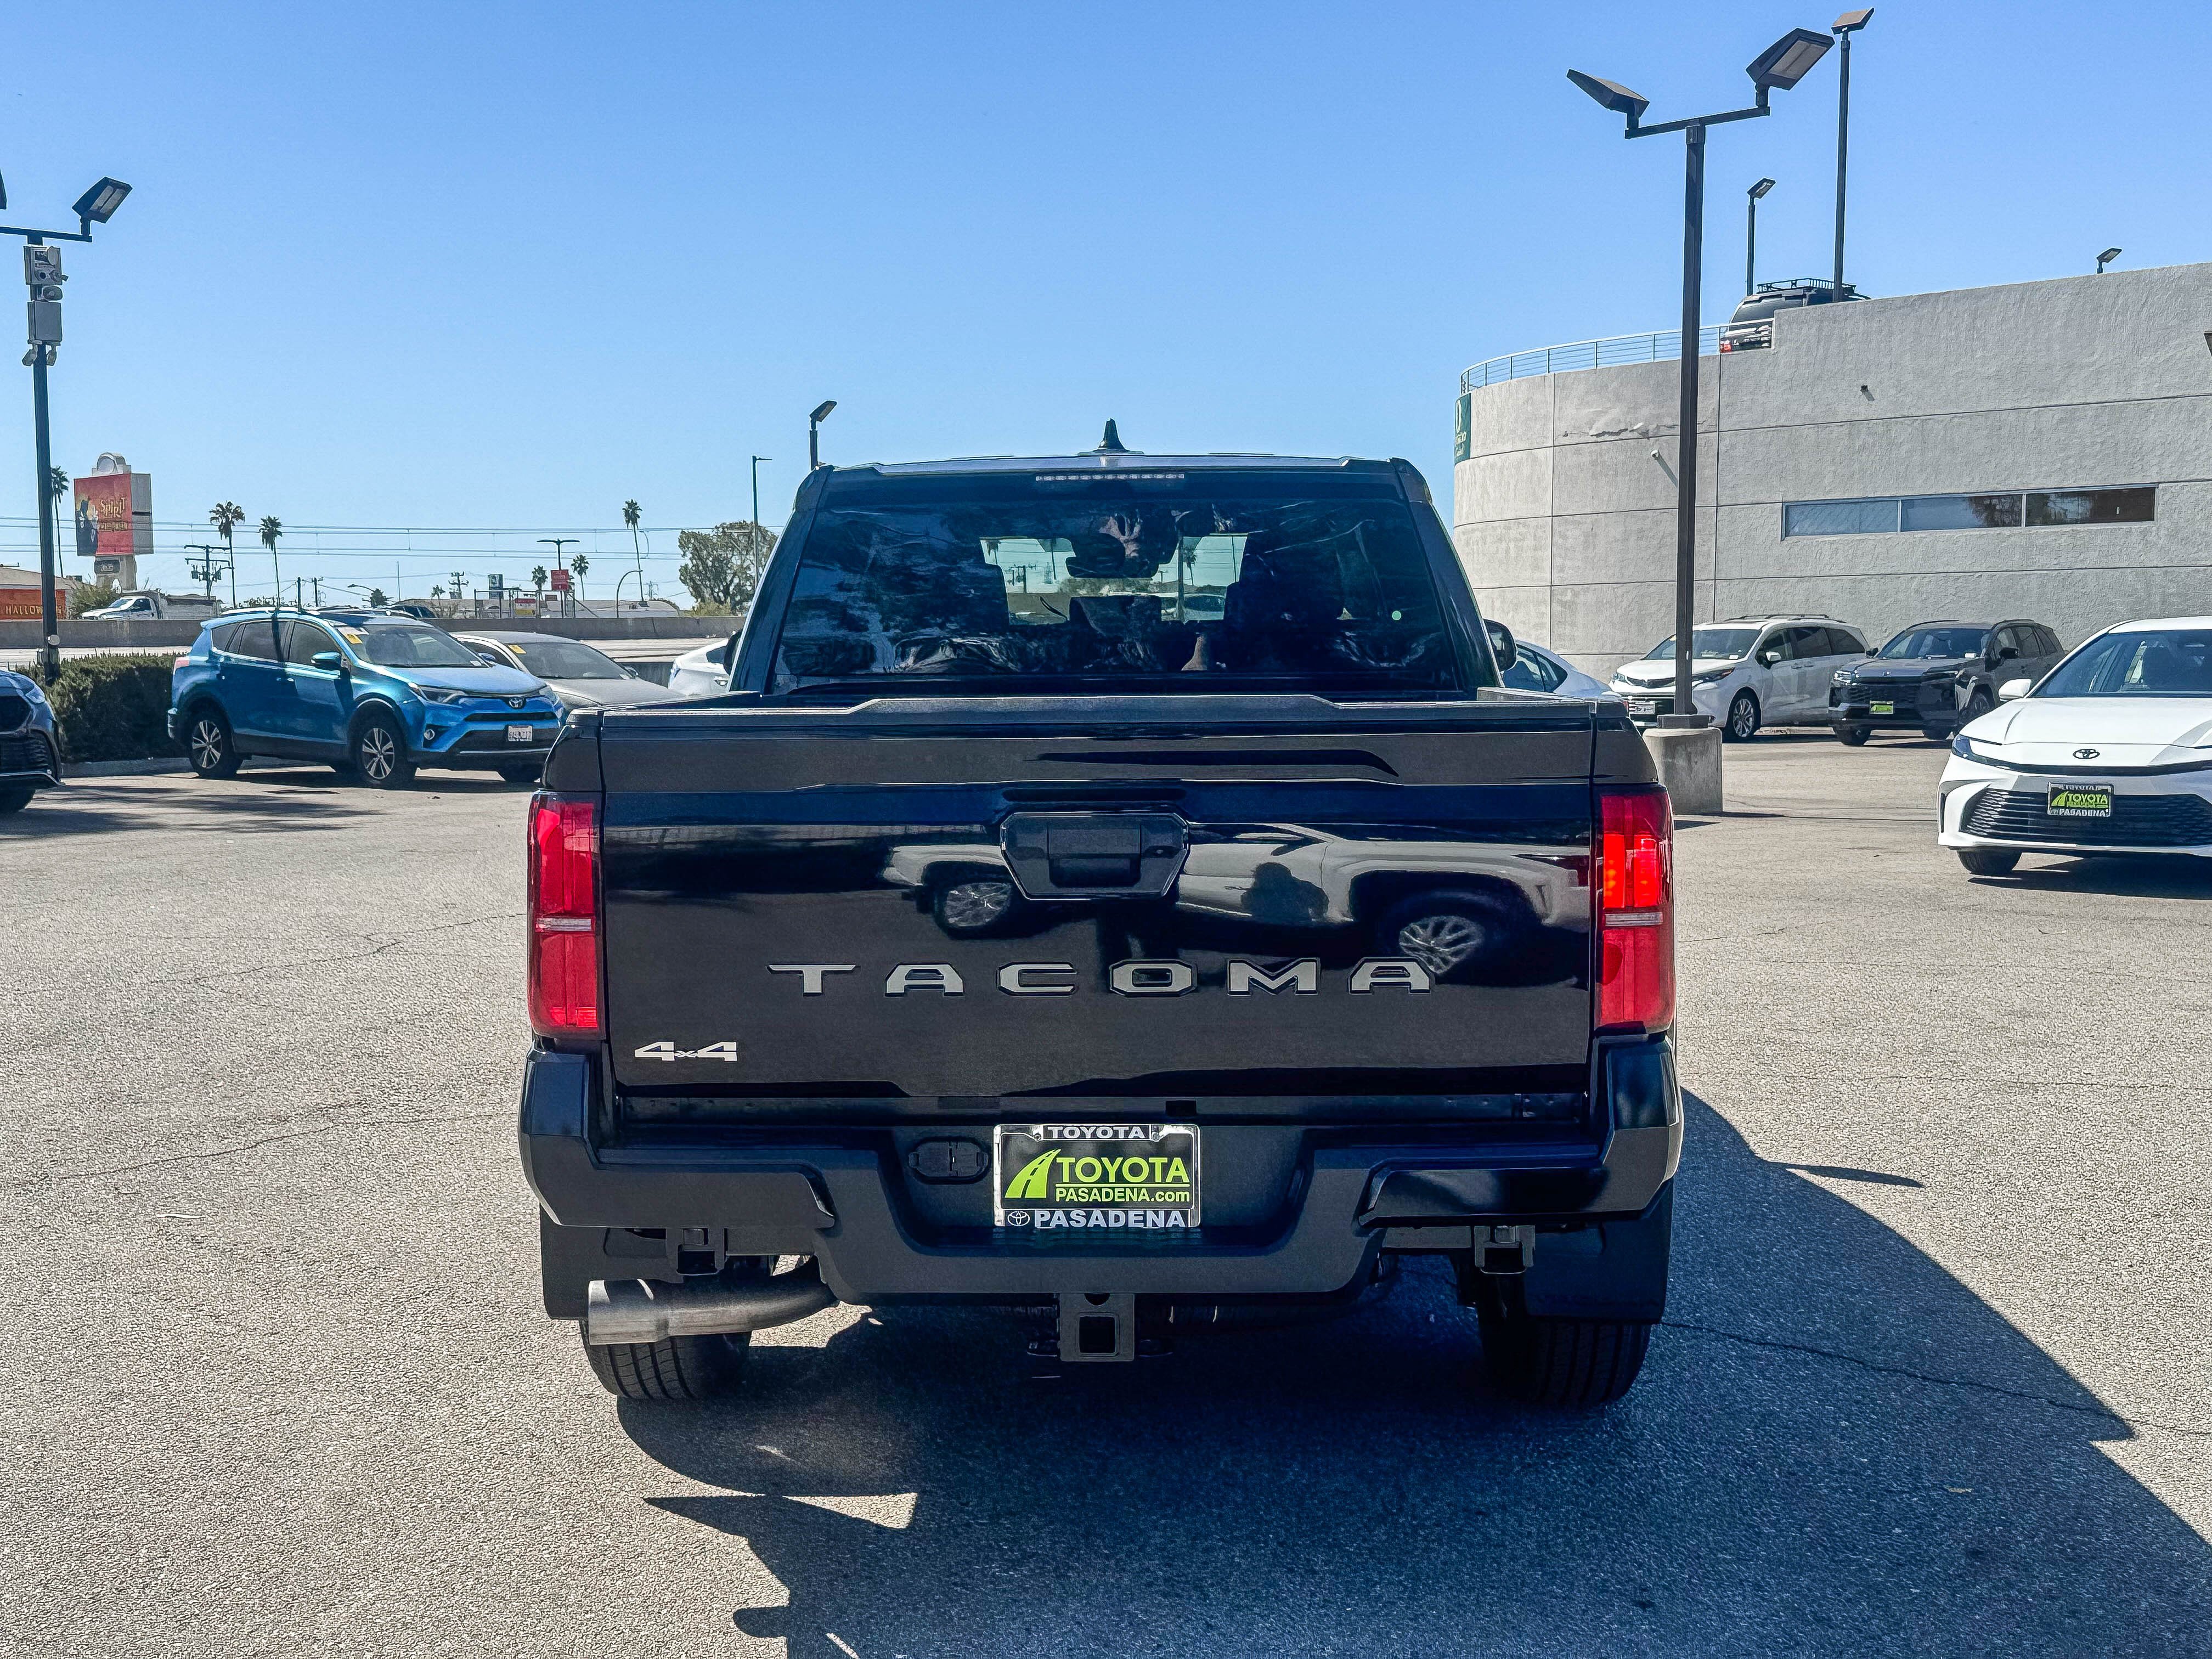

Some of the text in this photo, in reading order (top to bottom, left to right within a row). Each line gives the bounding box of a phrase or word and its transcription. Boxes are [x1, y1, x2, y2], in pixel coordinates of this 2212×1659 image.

[2067, 793, 2108, 804] TOYOTA
[767, 958, 1432, 996] TACOMA
[634, 1041, 738, 1062] 4x4
[1047, 1126, 1145, 1139] TOYOTA
[1056, 1156, 1190, 1183] TOYOTA
[1055, 1188, 1190, 1203] PASADENA.com
[1034, 1210, 1186, 1228] PASADENA
